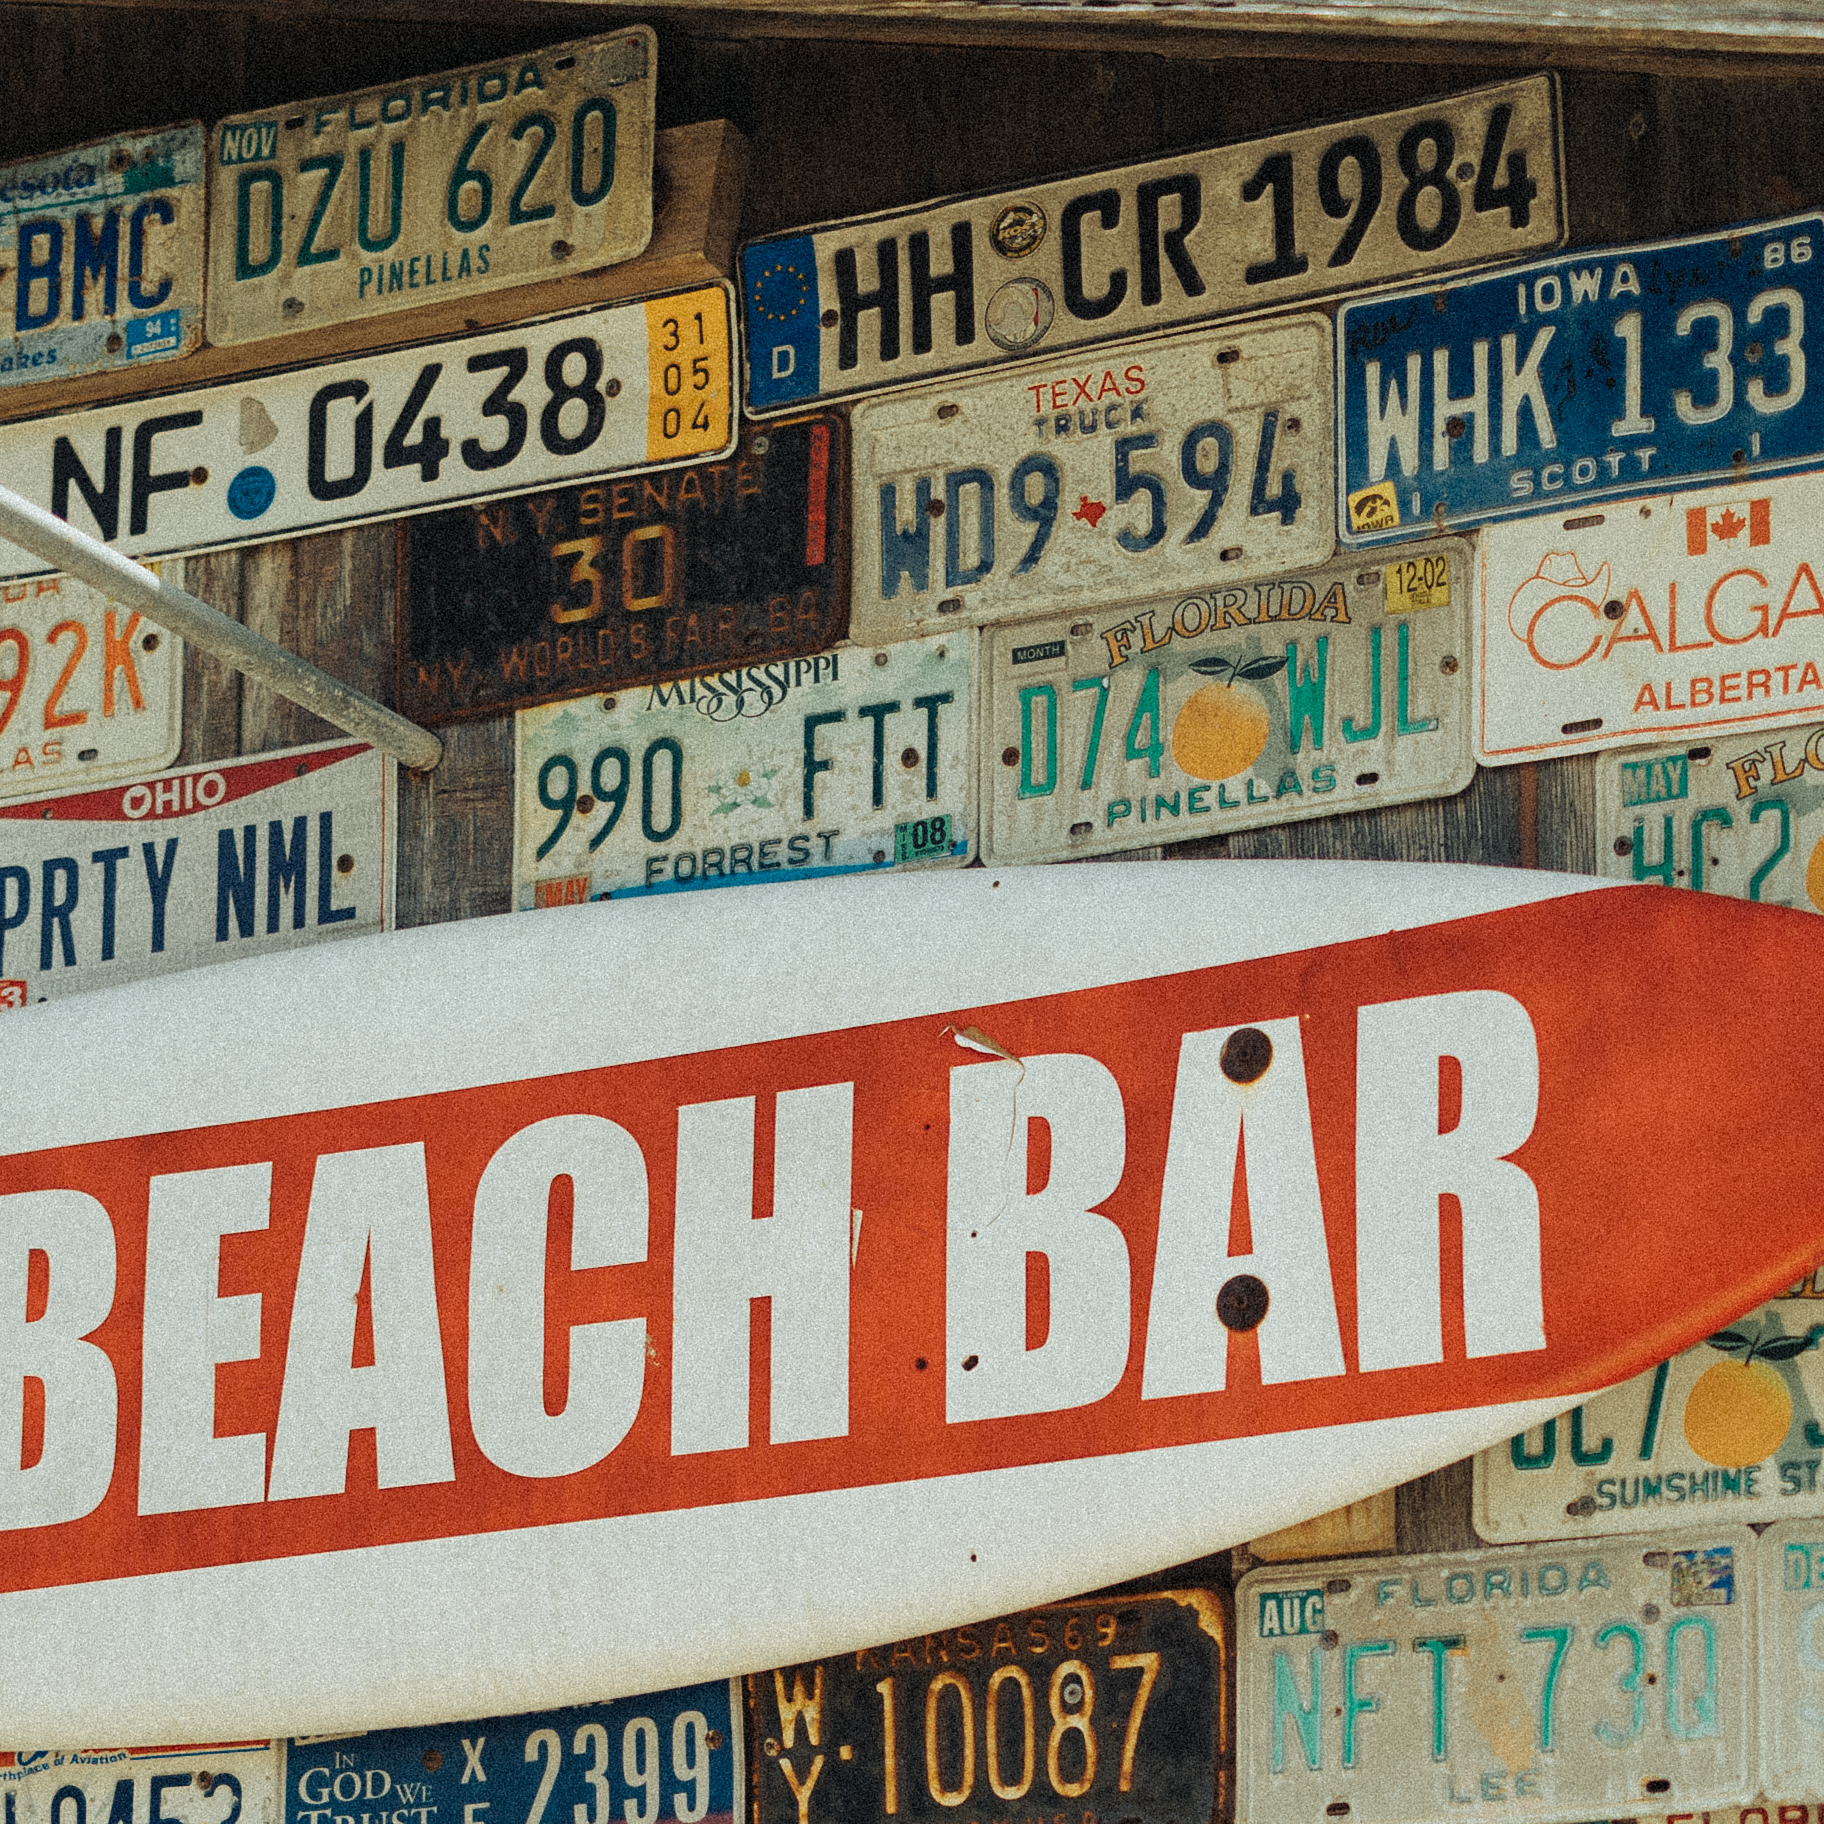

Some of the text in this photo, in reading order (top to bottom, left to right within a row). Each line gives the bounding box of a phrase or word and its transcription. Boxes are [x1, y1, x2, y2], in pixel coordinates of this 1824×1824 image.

[314, 61, 547, 136] FLORIDA
[221, 126, 276, 163] NOV
[234, 97, 616, 282] DZU 620
[1241, 104, 1537, 286] 1984
[15, 197, 175, 334] BMC
[359, 244, 491, 299] PINELLAS
[1516, 261, 1642, 317] IOWA
[1763, 237, 1813, 271] 86
[661, 311, 706, 352] 31
[664, 354, 710, 396] 05
[772, 346, 794, 379] D
[1028, 364, 1147, 415] TEXAS
[1365, 286, 1807, 484] WHK 133
[307, 336, 604, 502] 0438
[661, 406, 712, 441] 04
[1034, 401, 1150, 439] TRUCK
[1509, 447, 1658, 498] SCOTT
[879, 409, 1302, 600] WD9 594
[550, 523, 678, 624] 30
[1101, 580, 1353, 669] FLORIDA
[1016, 621, 1438, 801] D74 WJL
[1633, 661, 1824, 714] ALBERTA
[121, 772, 227, 820] OHIO
[536, 690, 956, 861] 990 FTT
[1107, 763, 1339, 828] PINELLAS
[1625, 756, 1685, 805] MAY
[216, 811, 356, 944] NML
[644, 830, 842, 888] FORREST
[945, 988, 1548, 1424] BAR
[1596, 1461, 1762, 1513] SUNSHINE
[1261, 1591, 1325, 1636] AUG
[333, 1750, 357, 1770] IN
[876, 1652, 1162, 1816] 10087
[297, 1765, 434, 1808] GOD WE
[1448, 1768, 1545, 1805] LEE
